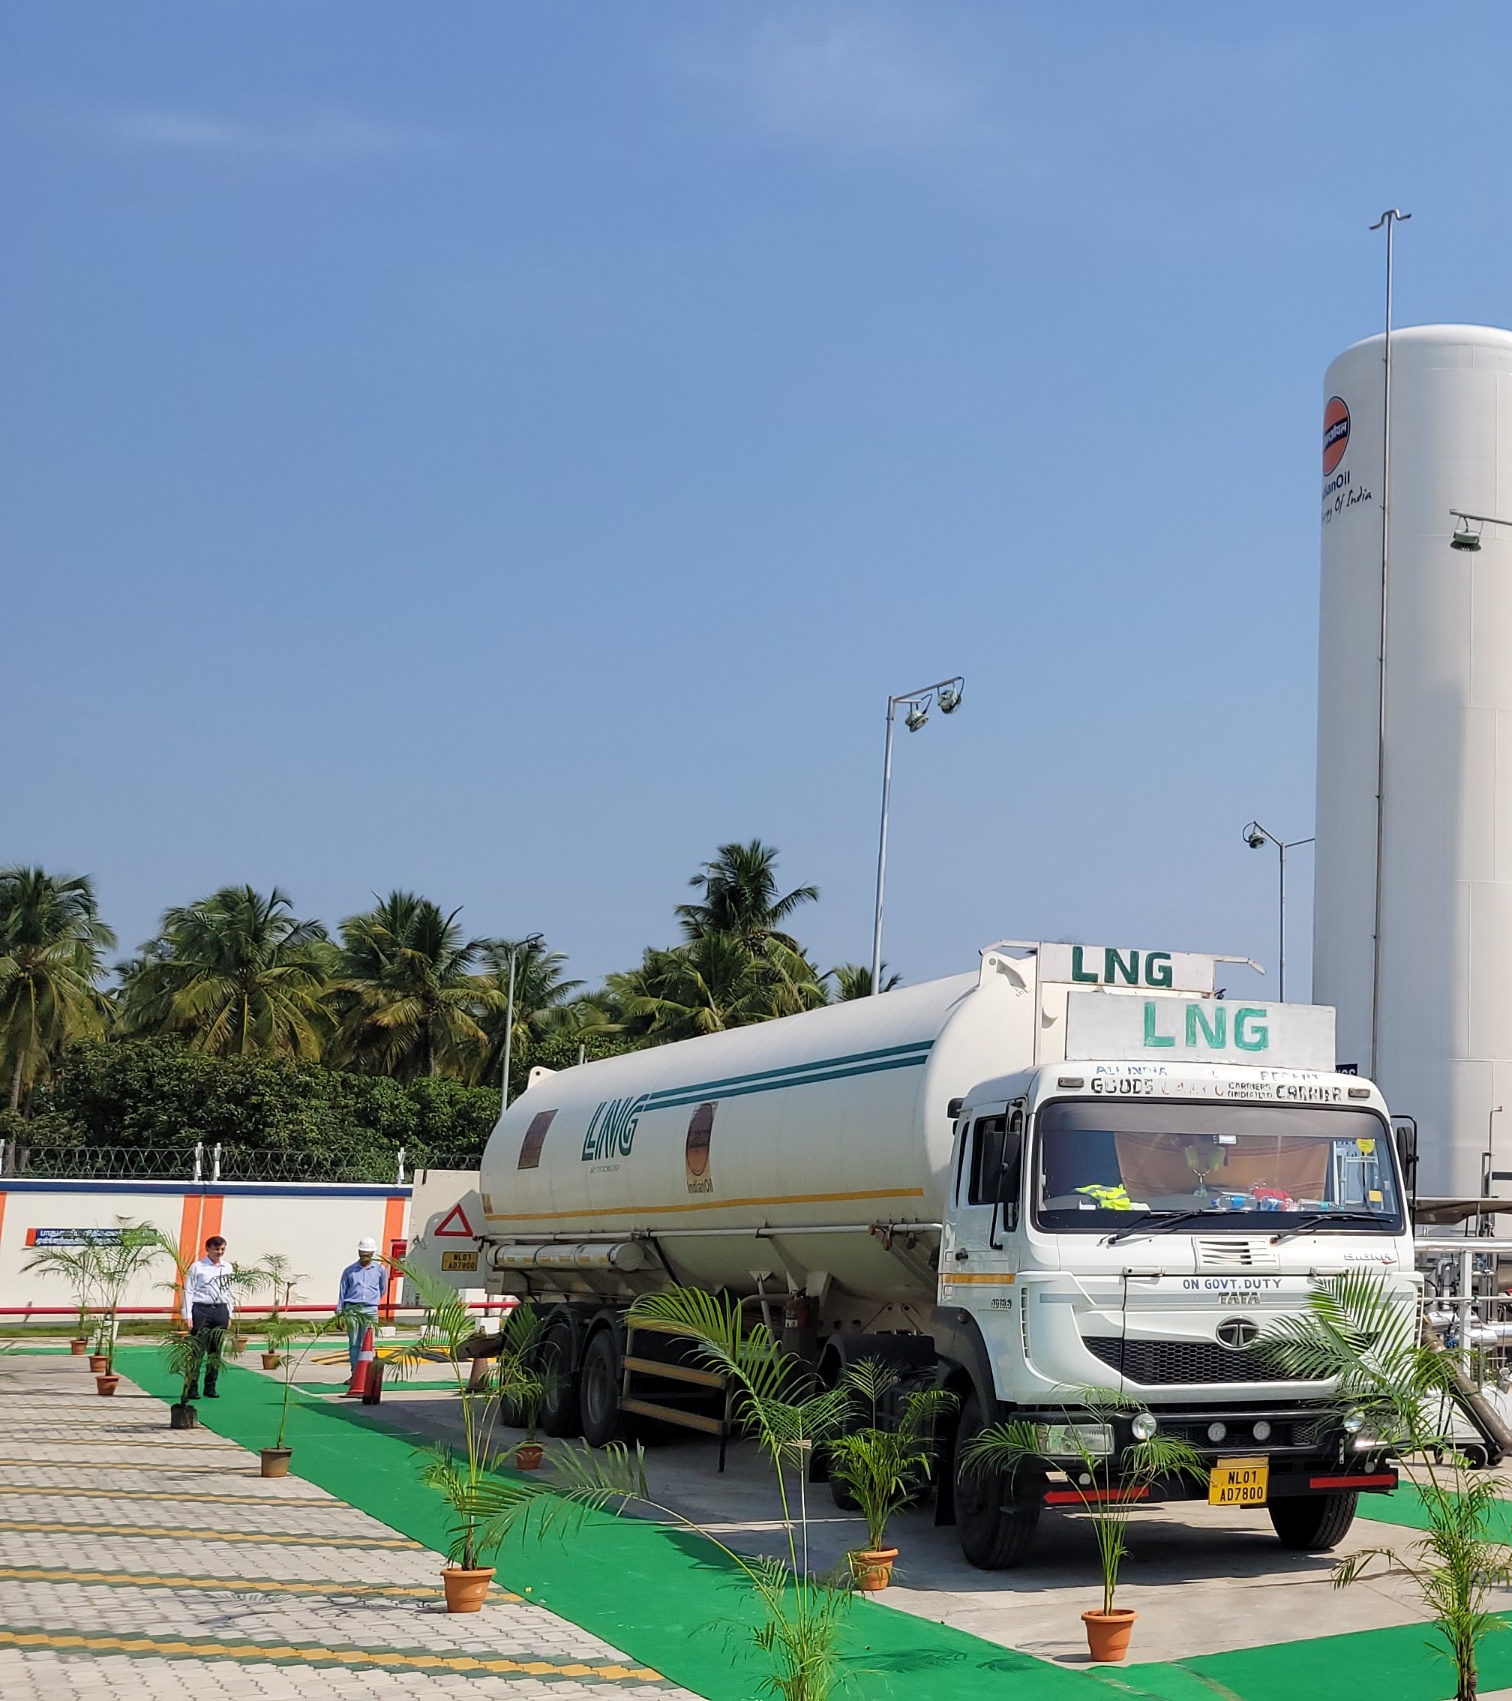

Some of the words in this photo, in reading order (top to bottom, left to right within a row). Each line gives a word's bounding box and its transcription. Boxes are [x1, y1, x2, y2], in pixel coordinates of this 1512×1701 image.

[1346, 486, 1372, 507] India
[1072, 946, 1173, 988] LNG
[1143, 1001, 1269, 1051] LNG
[581, 1096, 644, 1161] LNG
[1183, 1279, 1199, 1289] ON
[1218, 1291, 1260, 1304] TATA
[1228, 1471, 1257, 1485] NL01
[1220, 1486, 1263, 1502] AD7800
